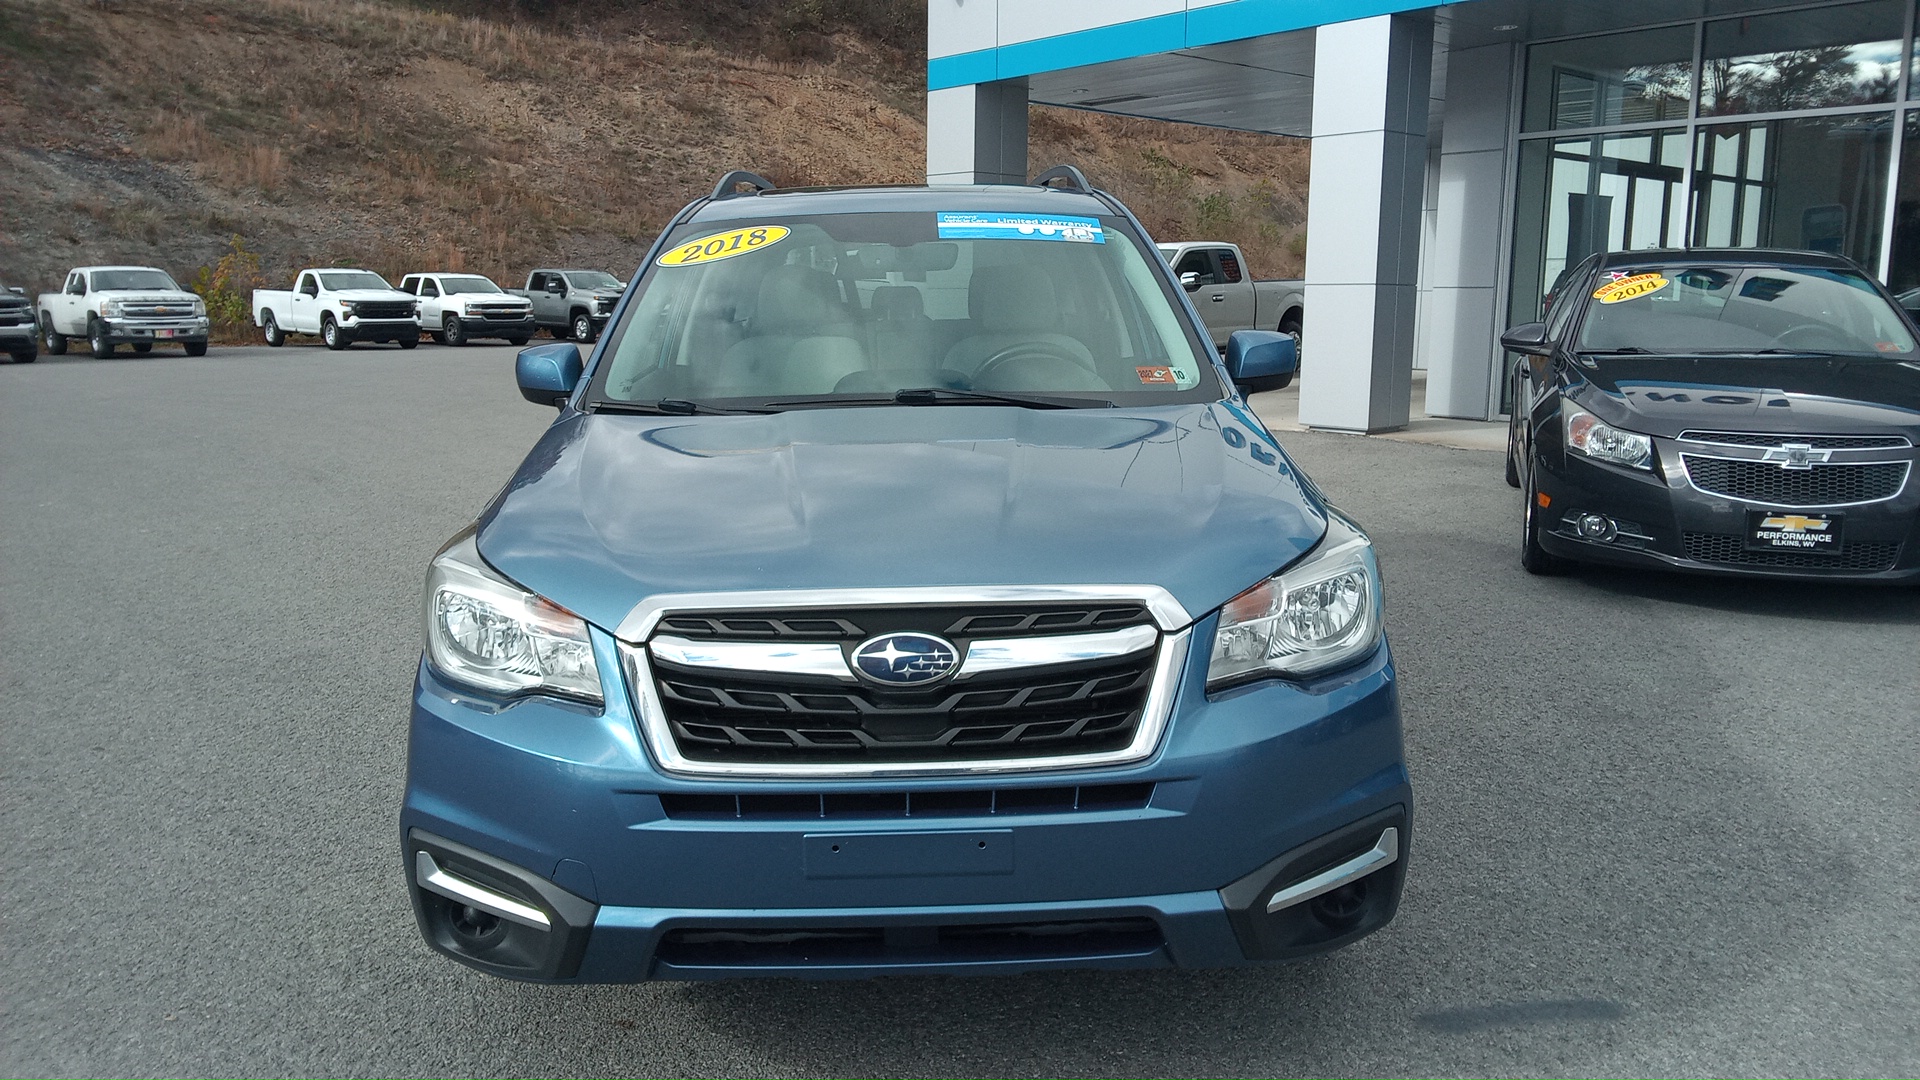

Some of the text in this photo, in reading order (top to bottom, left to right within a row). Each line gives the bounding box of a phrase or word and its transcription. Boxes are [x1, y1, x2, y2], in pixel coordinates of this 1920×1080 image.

[997, 217, 1092, 228] Limited Warranty
[681, 229, 767, 263] 2018
[1597, 274, 1653, 295] ONE OWNER
[1614, 280, 1658, 300] 2014
[1173, 370, 1185, 380] 10
[1756, 531, 1832, 542] PERFORMANCE
[1772, 539, 1801, 548] ELKINS,
